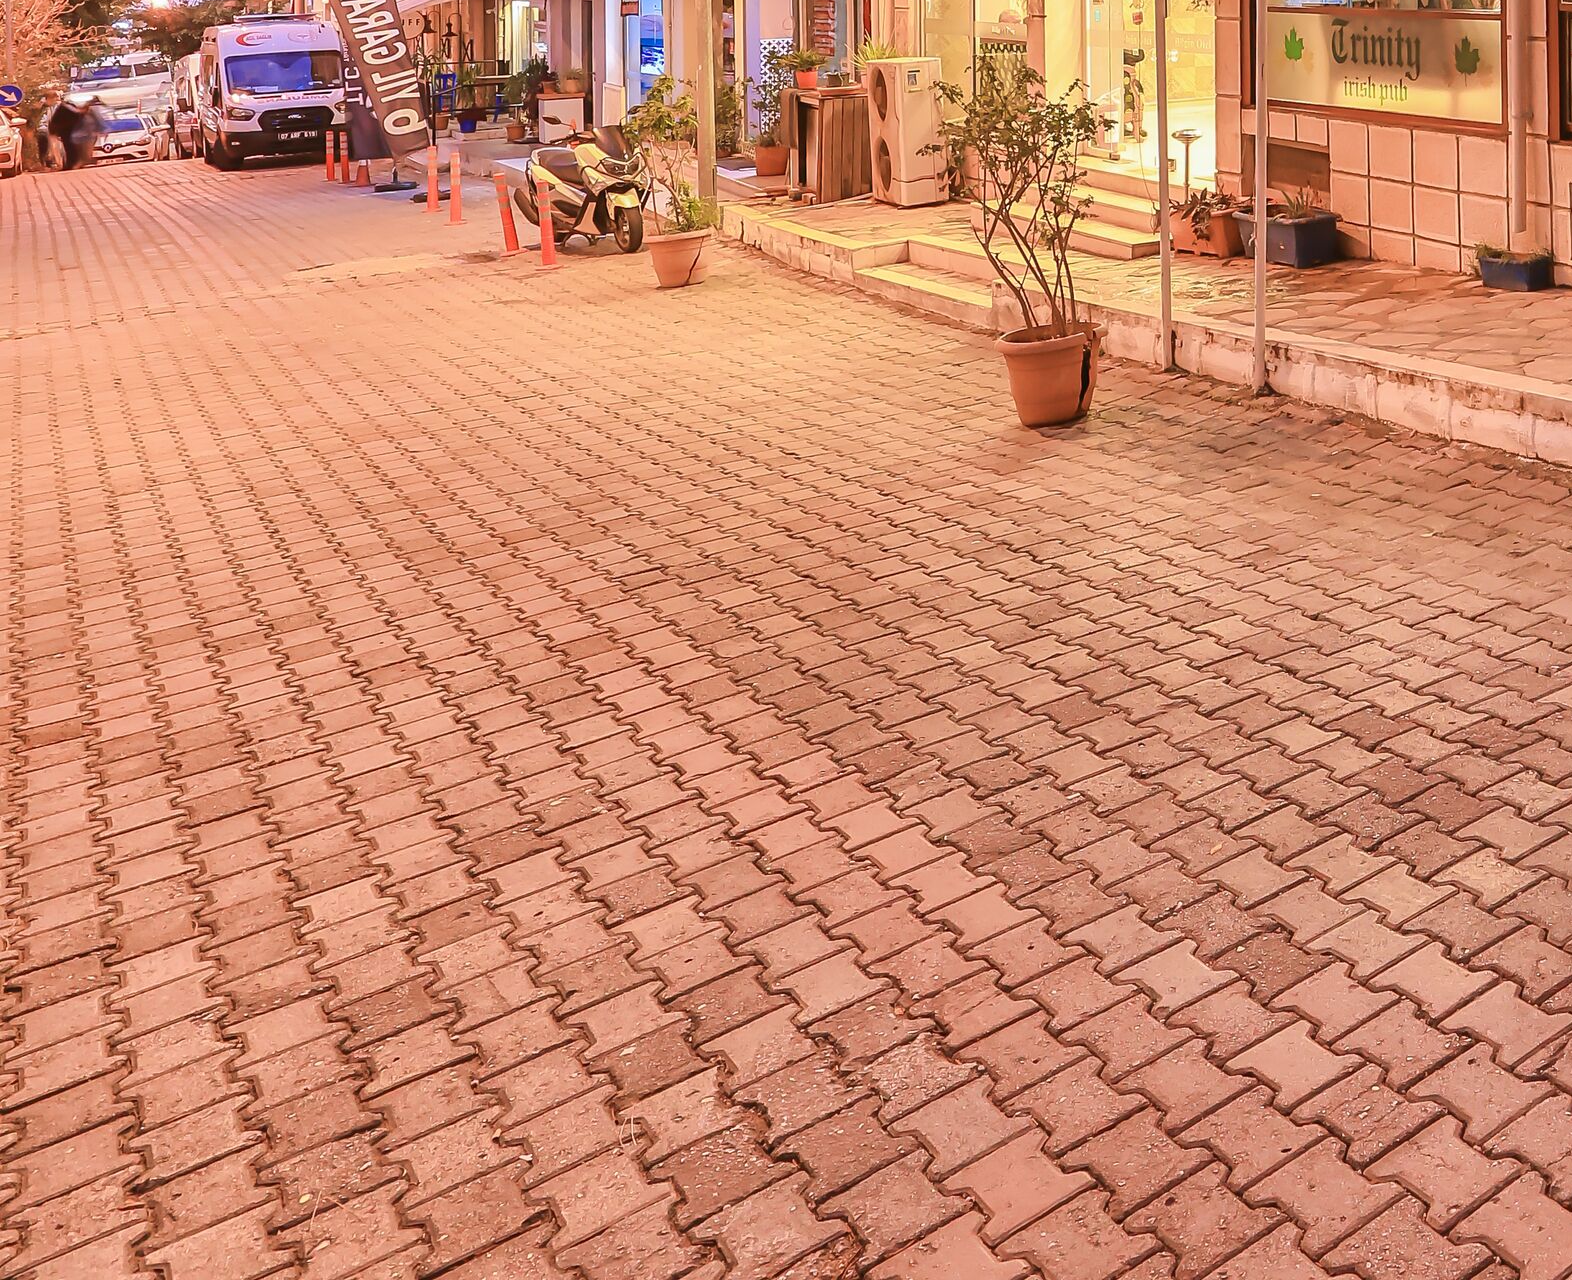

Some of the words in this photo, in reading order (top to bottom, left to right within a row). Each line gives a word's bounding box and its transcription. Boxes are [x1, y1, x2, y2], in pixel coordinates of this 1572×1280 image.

[1331, 17, 1421, 81] Trinity
[1343, 75, 1376, 99] irish
[1379, 78, 1408, 106] pub
